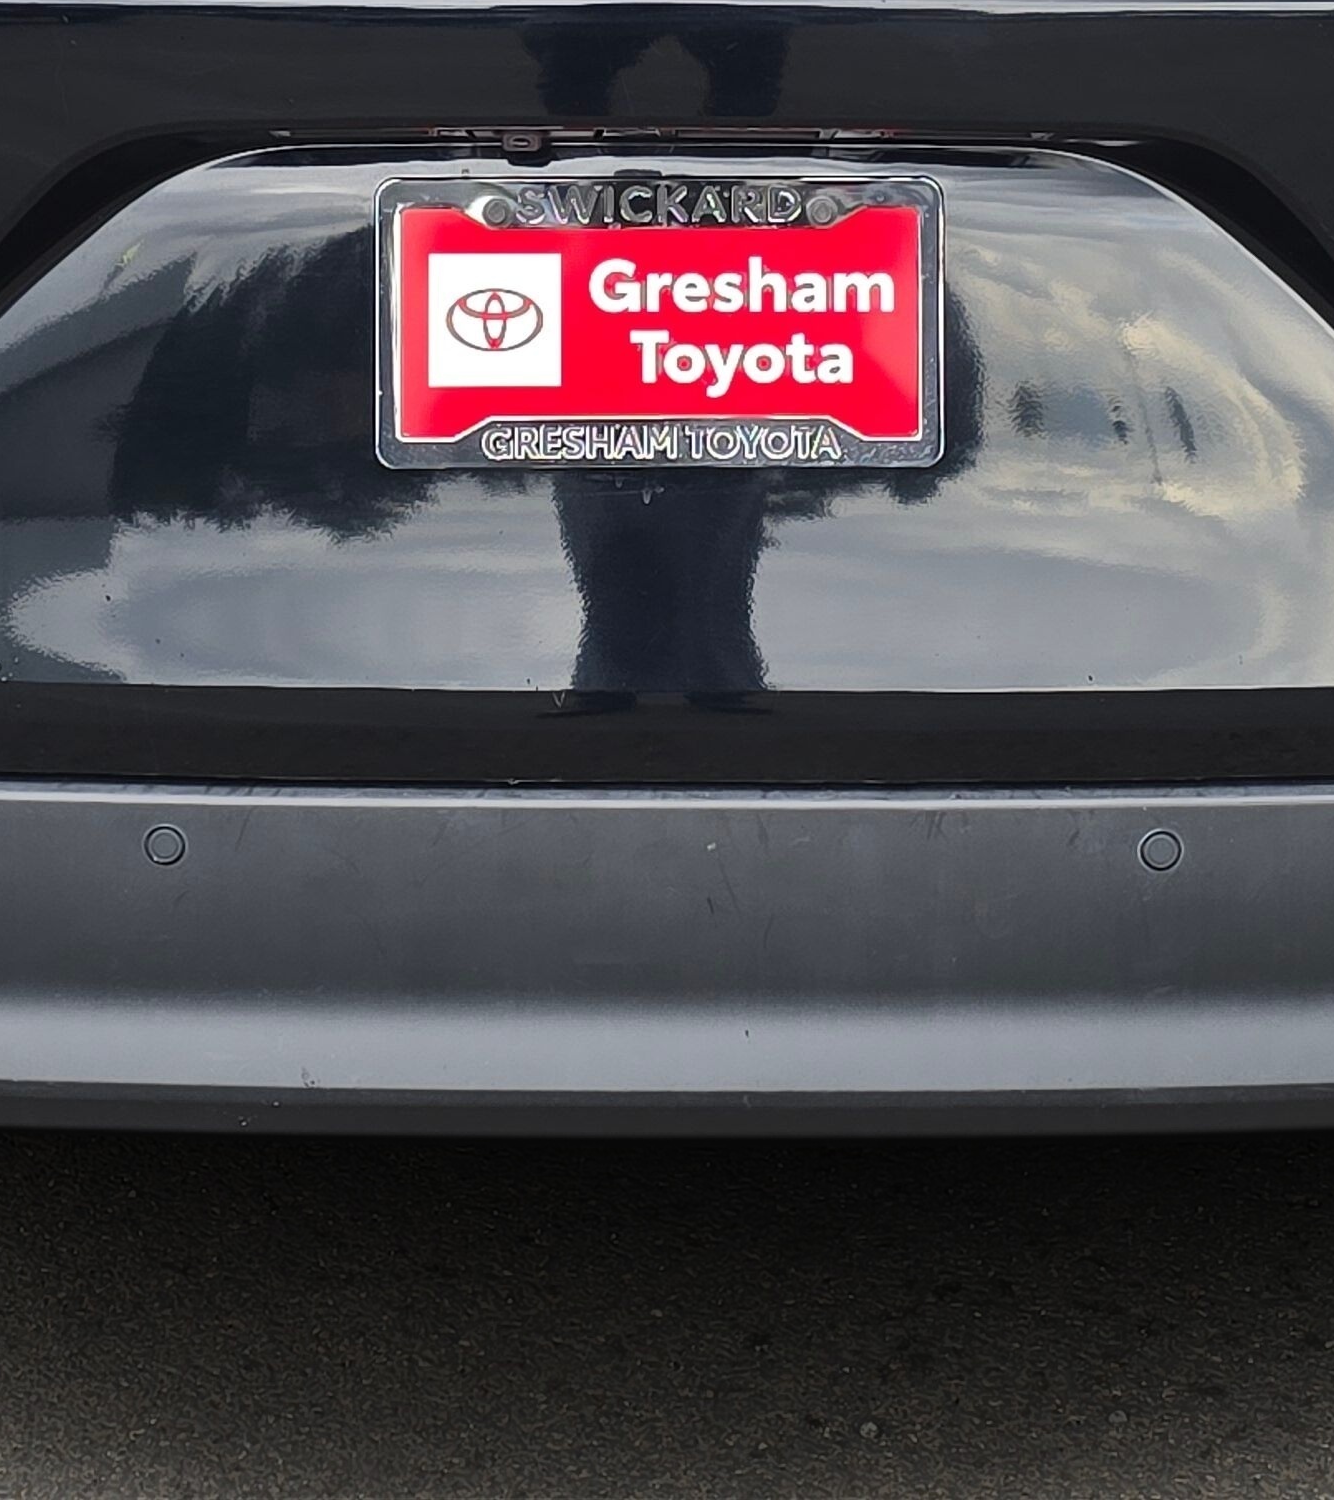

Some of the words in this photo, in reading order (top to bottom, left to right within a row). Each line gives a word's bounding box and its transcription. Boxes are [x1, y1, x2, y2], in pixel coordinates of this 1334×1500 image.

[515, 184, 802, 225] SWICKARD
[589, 257, 895, 313] Gresham
[630, 330, 854, 397] Toyota
[481, 425, 679, 461] GRESHAM
[686, 425, 843, 461] TOYOTA
